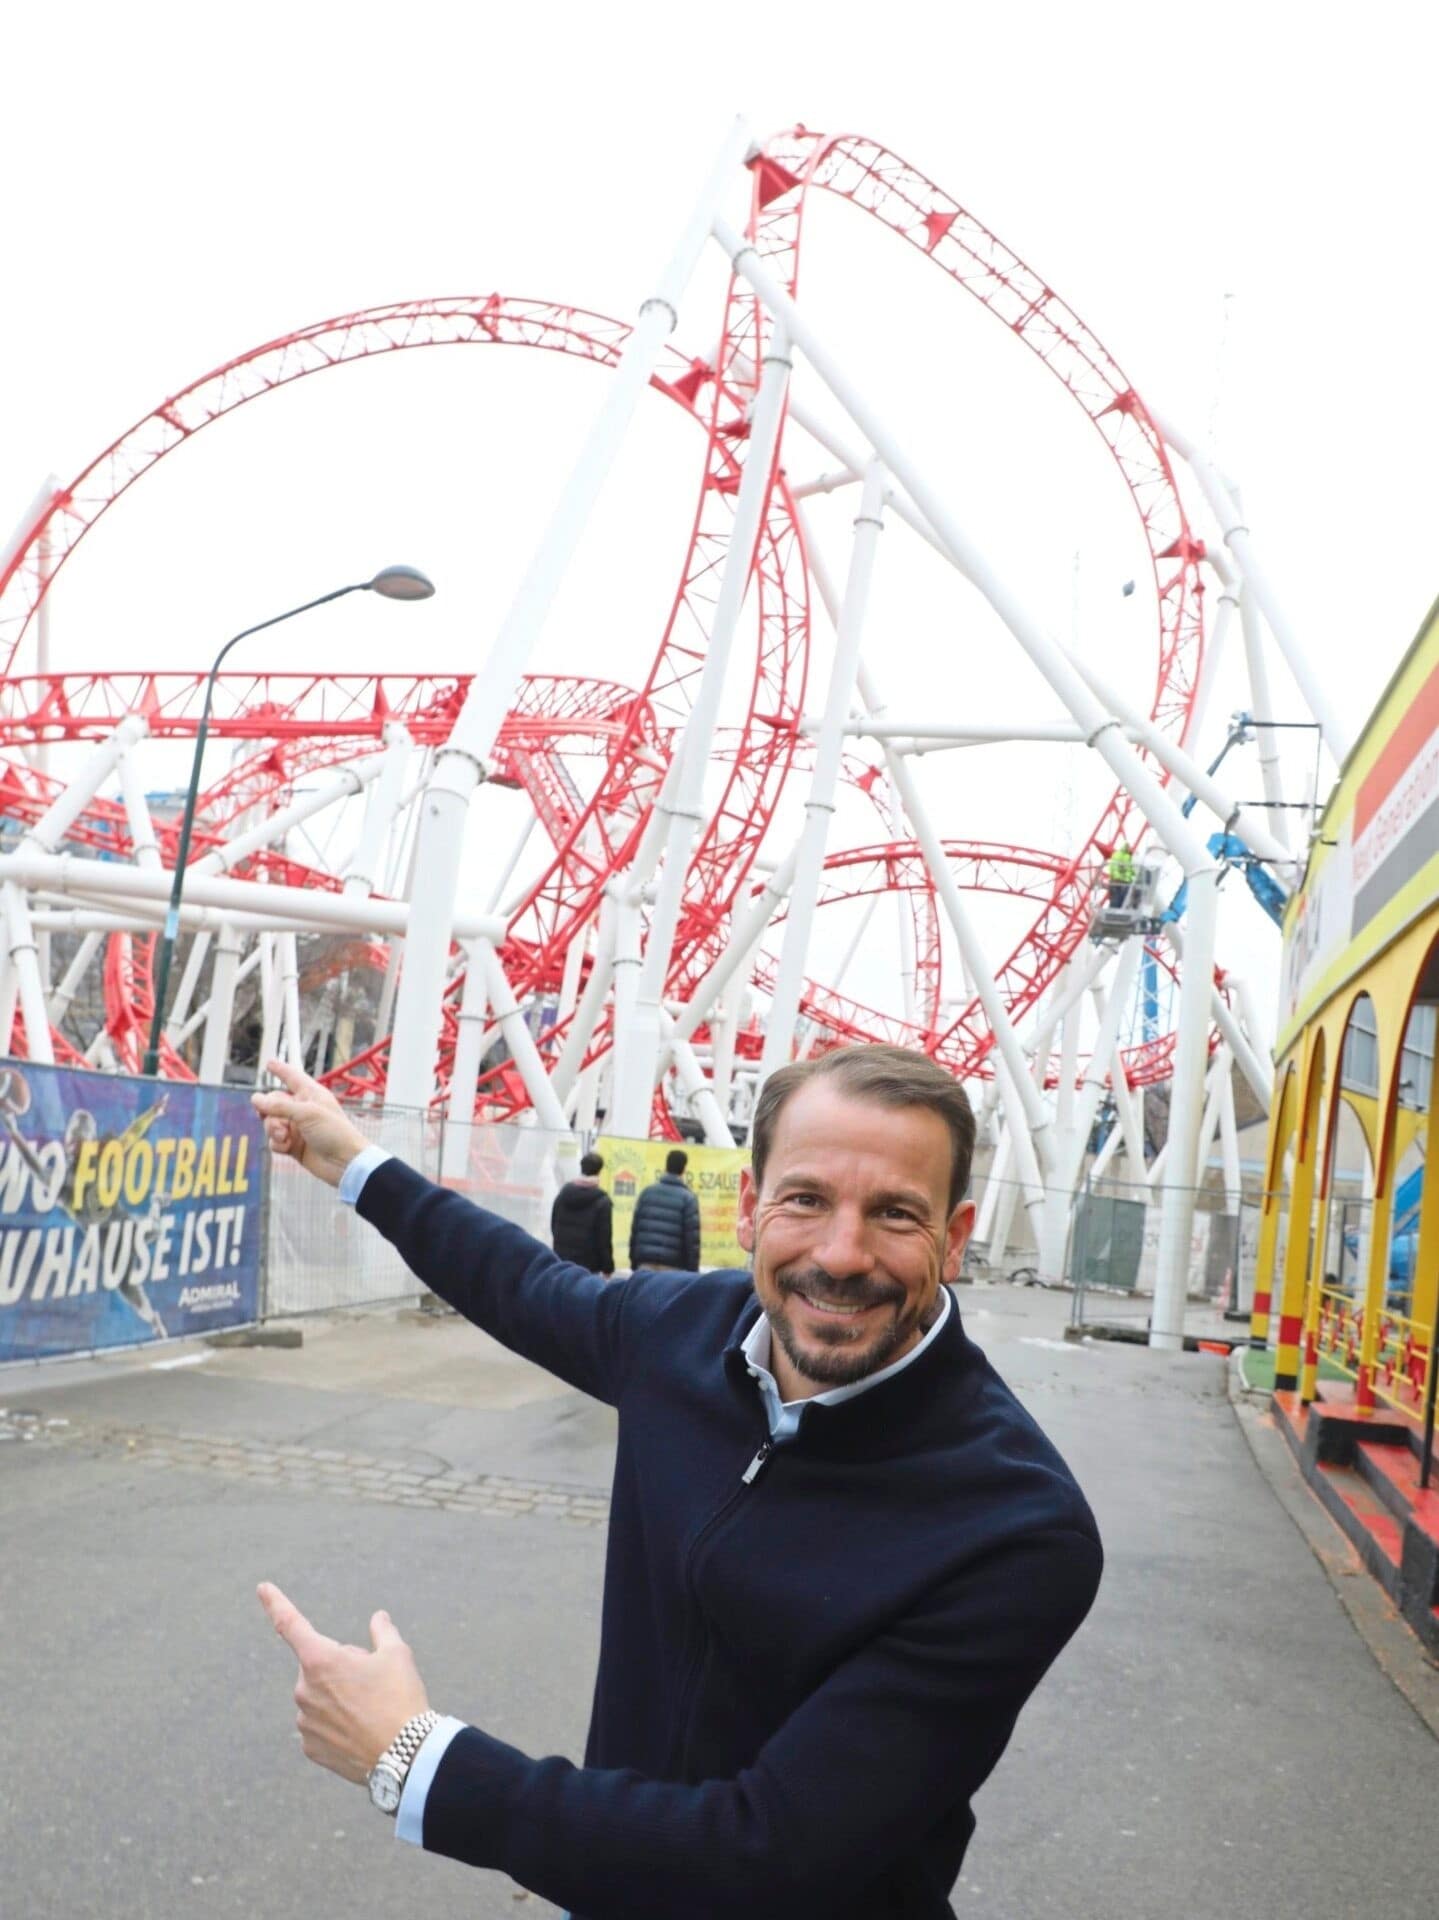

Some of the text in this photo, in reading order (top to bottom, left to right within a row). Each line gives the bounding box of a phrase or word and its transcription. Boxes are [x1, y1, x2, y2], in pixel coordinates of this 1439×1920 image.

[72, 1135, 249, 1210] FOOTBALL
[0, 1205, 246, 1305] UHAUSE IST!
[178, 1280, 241, 1308] ADMIRAL
